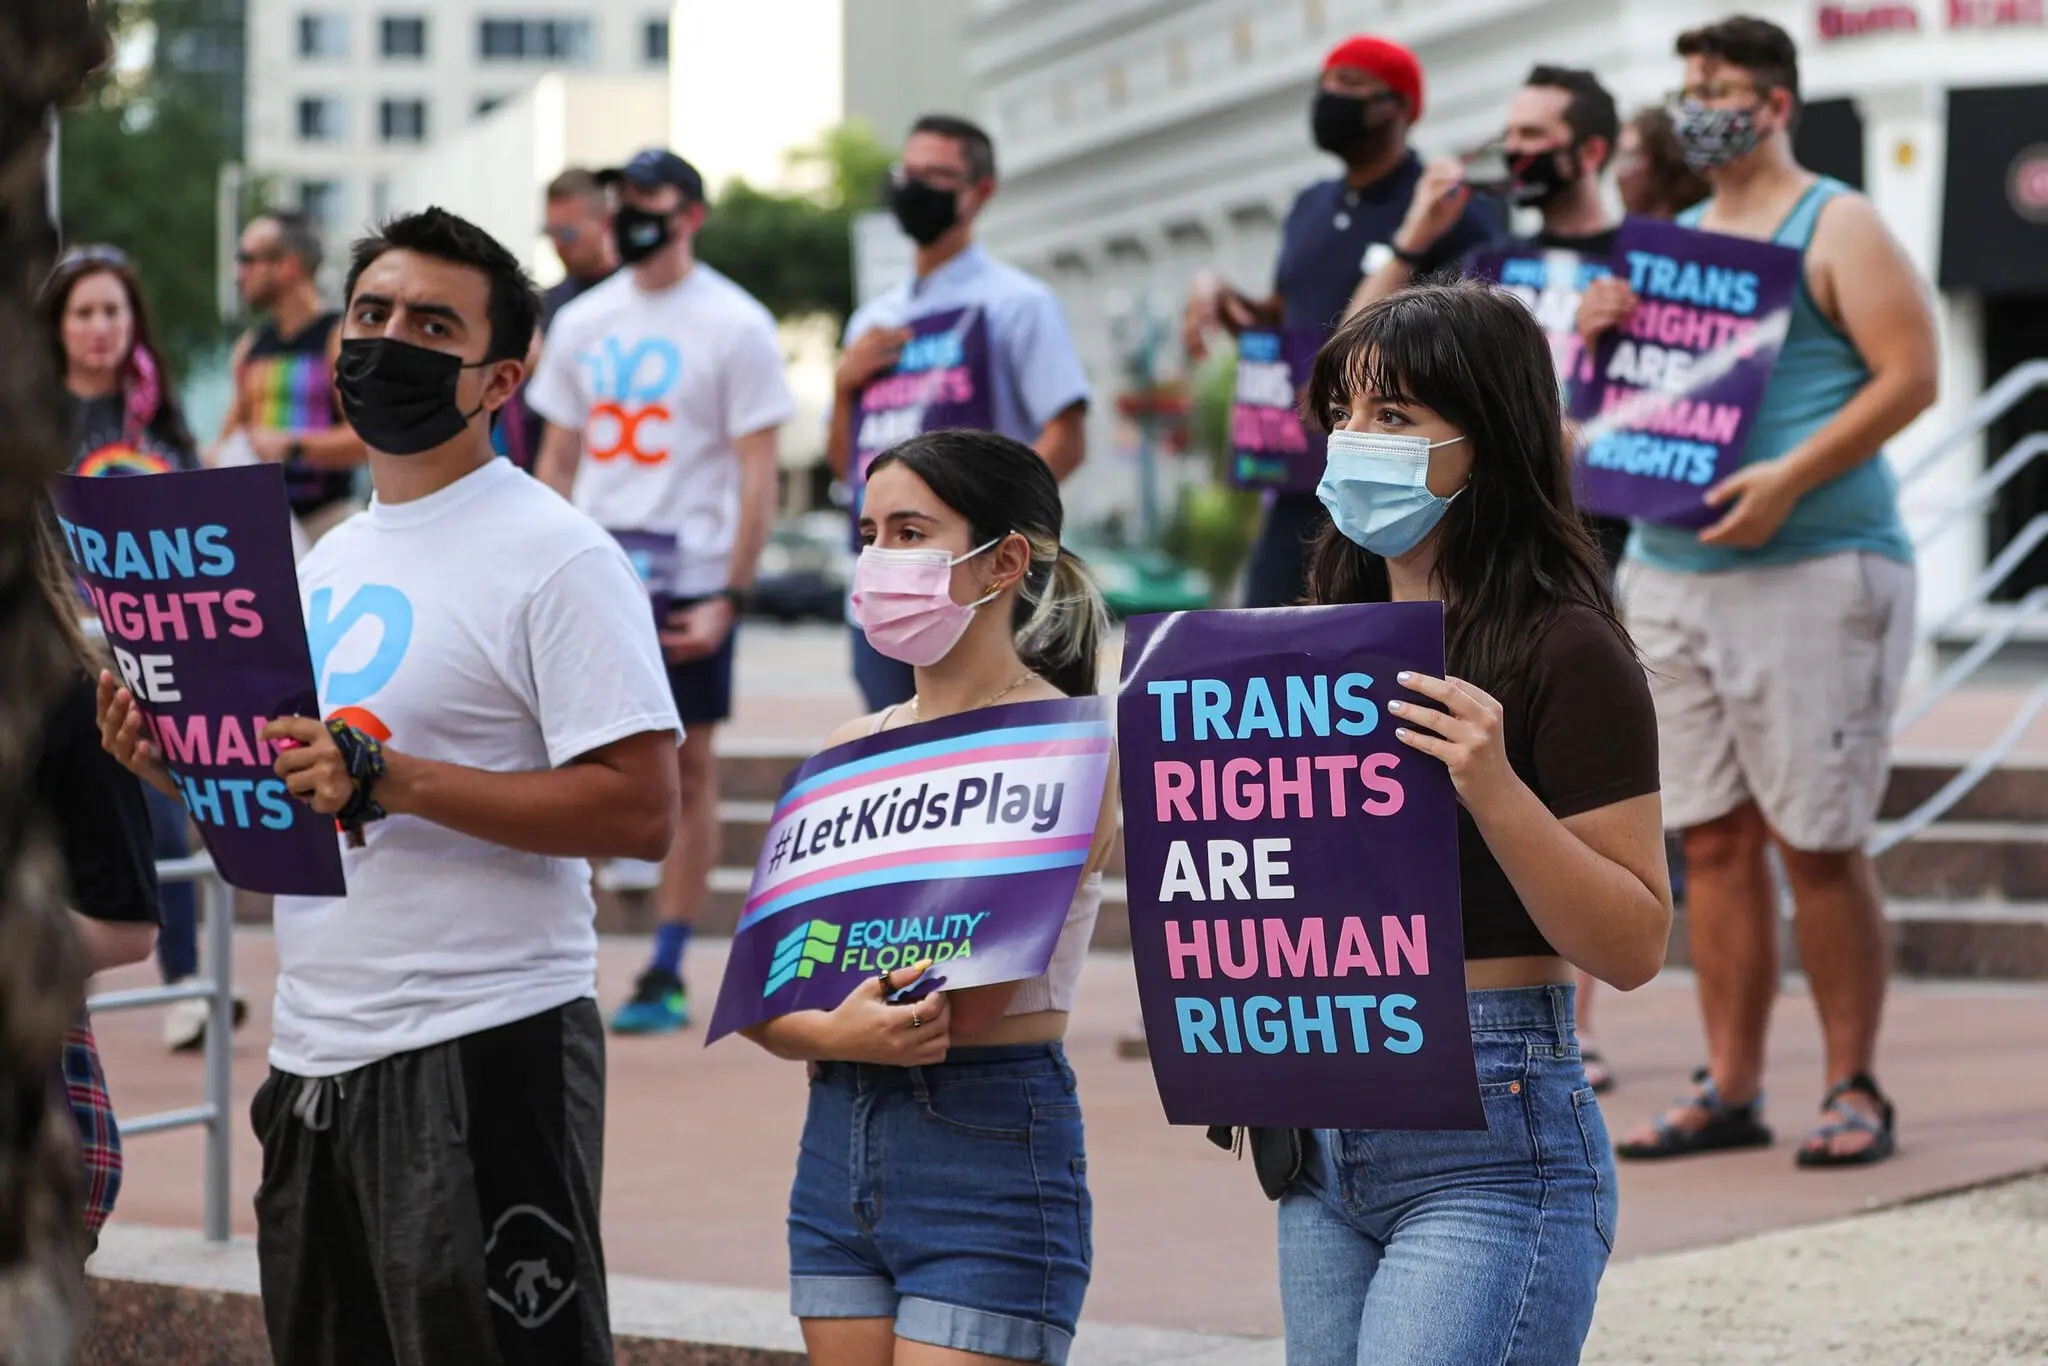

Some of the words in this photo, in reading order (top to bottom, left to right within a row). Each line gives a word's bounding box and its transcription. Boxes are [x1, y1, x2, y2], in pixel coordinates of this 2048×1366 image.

[1626, 250, 1759, 315] TRANS
[1605, 340, 1697, 392] ARE
[1587, 431, 1719, 485] RIGHTS
[57, 514, 235, 580] TRANS
[82, 579, 264, 641] IGHTS
[113, 645, 181, 702] RE
[1147, 672, 1379, 741] TRANS
[1153, 752, 1404, 822] RIGHTS
[768, 772, 1064, 874] #LetKidsPlay
[1158, 838, 1295, 902] ARE
[840, 938, 972, 972] FLORIDA
[846, 911, 985, 949] EQUALITY
[1164, 914, 1429, 980] HUMAN
[1174, 993, 1424, 1054] RIGHTS
